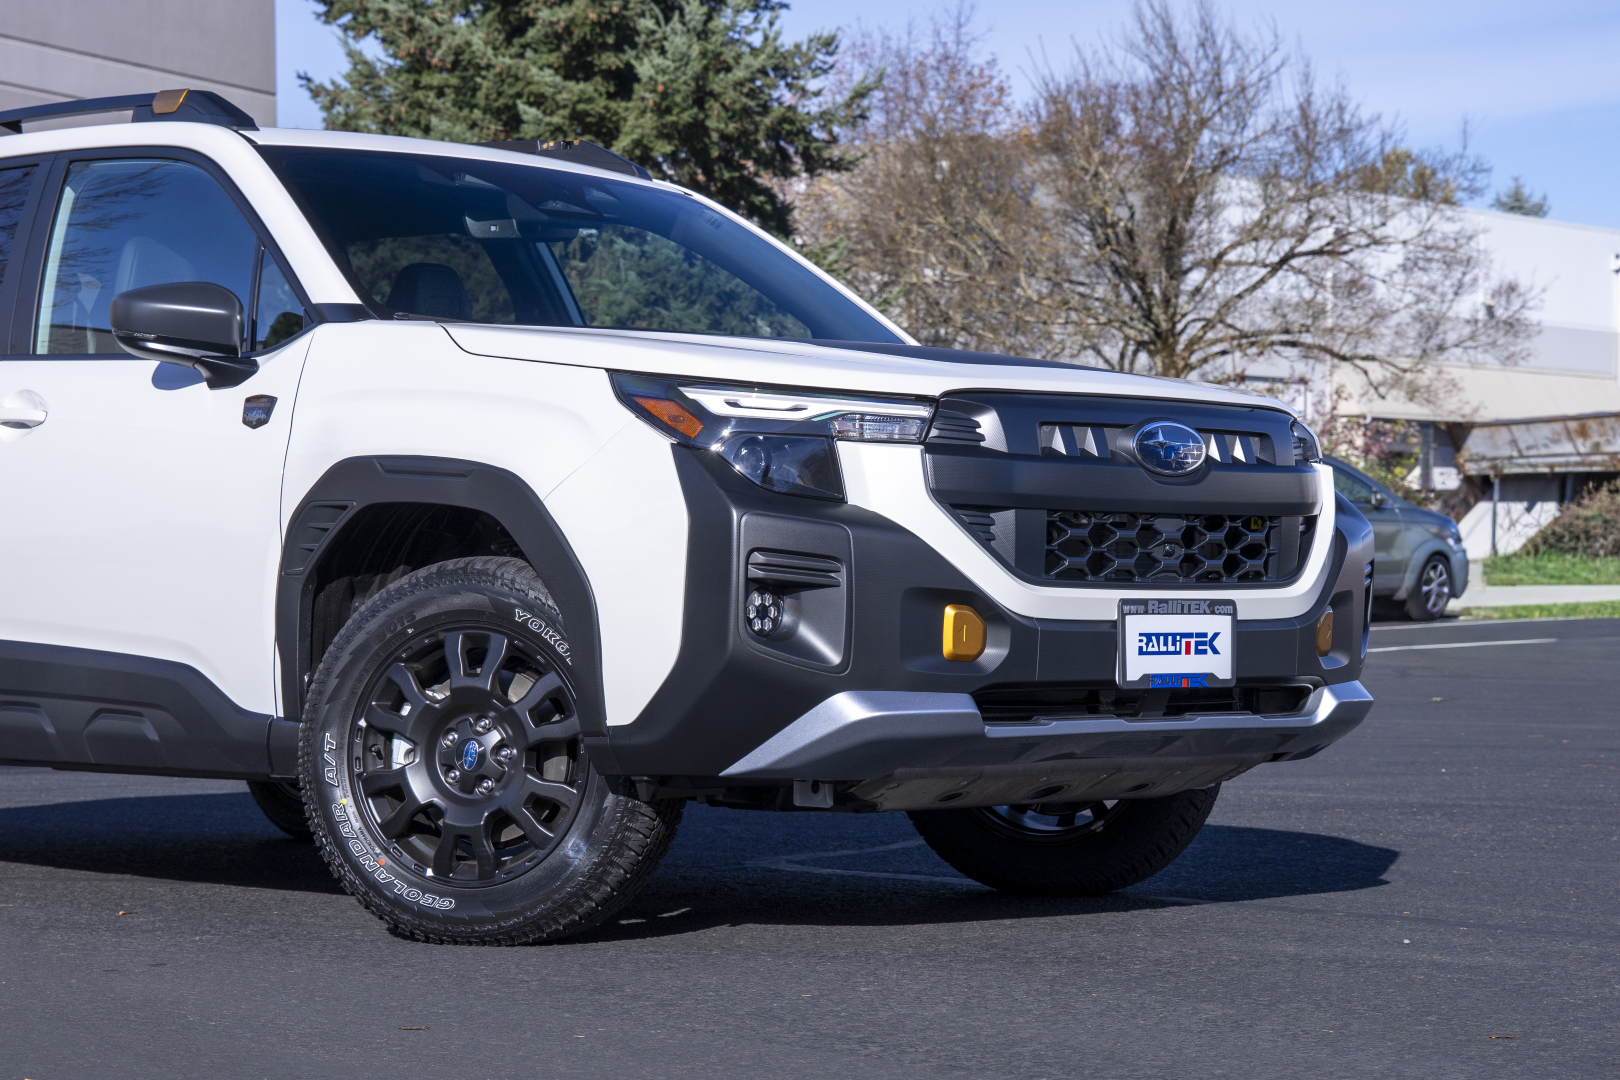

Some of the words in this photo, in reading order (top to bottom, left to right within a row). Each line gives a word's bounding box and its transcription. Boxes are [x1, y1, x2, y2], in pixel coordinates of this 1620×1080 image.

[1253, 518, 1259, 526] K
[1148, 600, 1210, 614] RalliTEK
[515, 608, 572, 666] YOKO
[324, 732, 339, 786] A/T
[332, 803, 455, 910] GEOLANDAR
